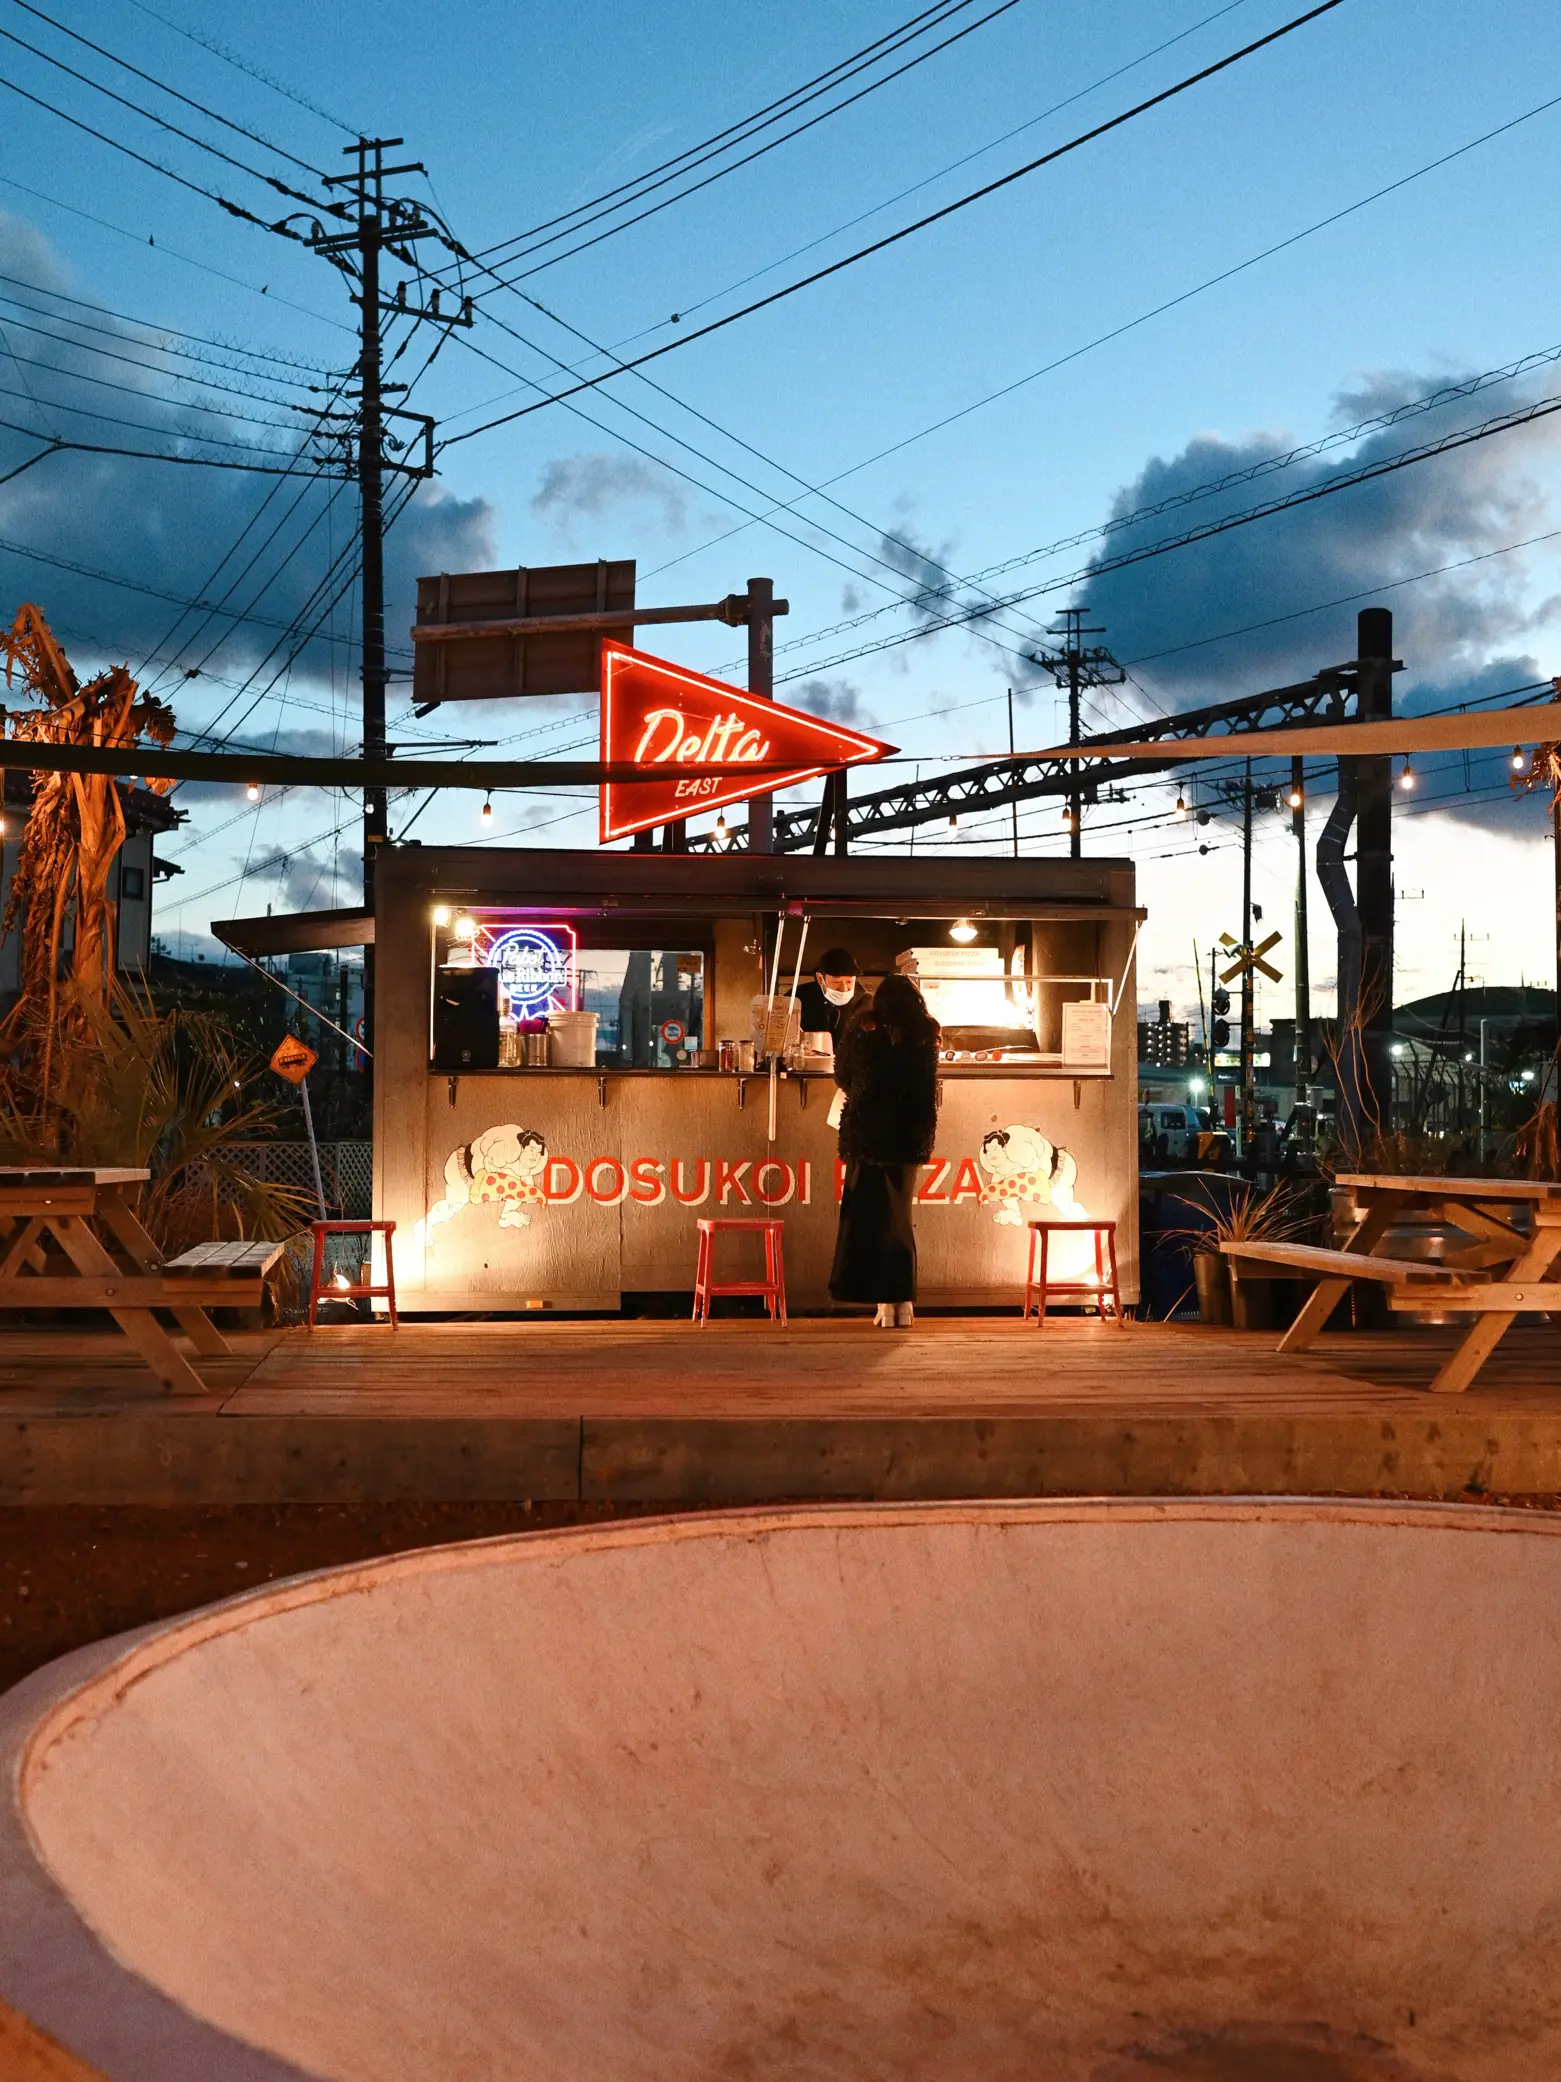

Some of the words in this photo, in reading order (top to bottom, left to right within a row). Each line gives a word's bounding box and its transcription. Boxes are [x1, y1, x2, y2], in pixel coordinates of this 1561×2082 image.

[634, 708, 770, 763] Delta
[674, 777, 723, 798] EAST
[500, 942, 549, 966] Pabst
[516, 966, 564, 983] Ribbon
[509, 983, 538, 993] BEER
[543, 1155, 811, 1207] DOSUKOI
